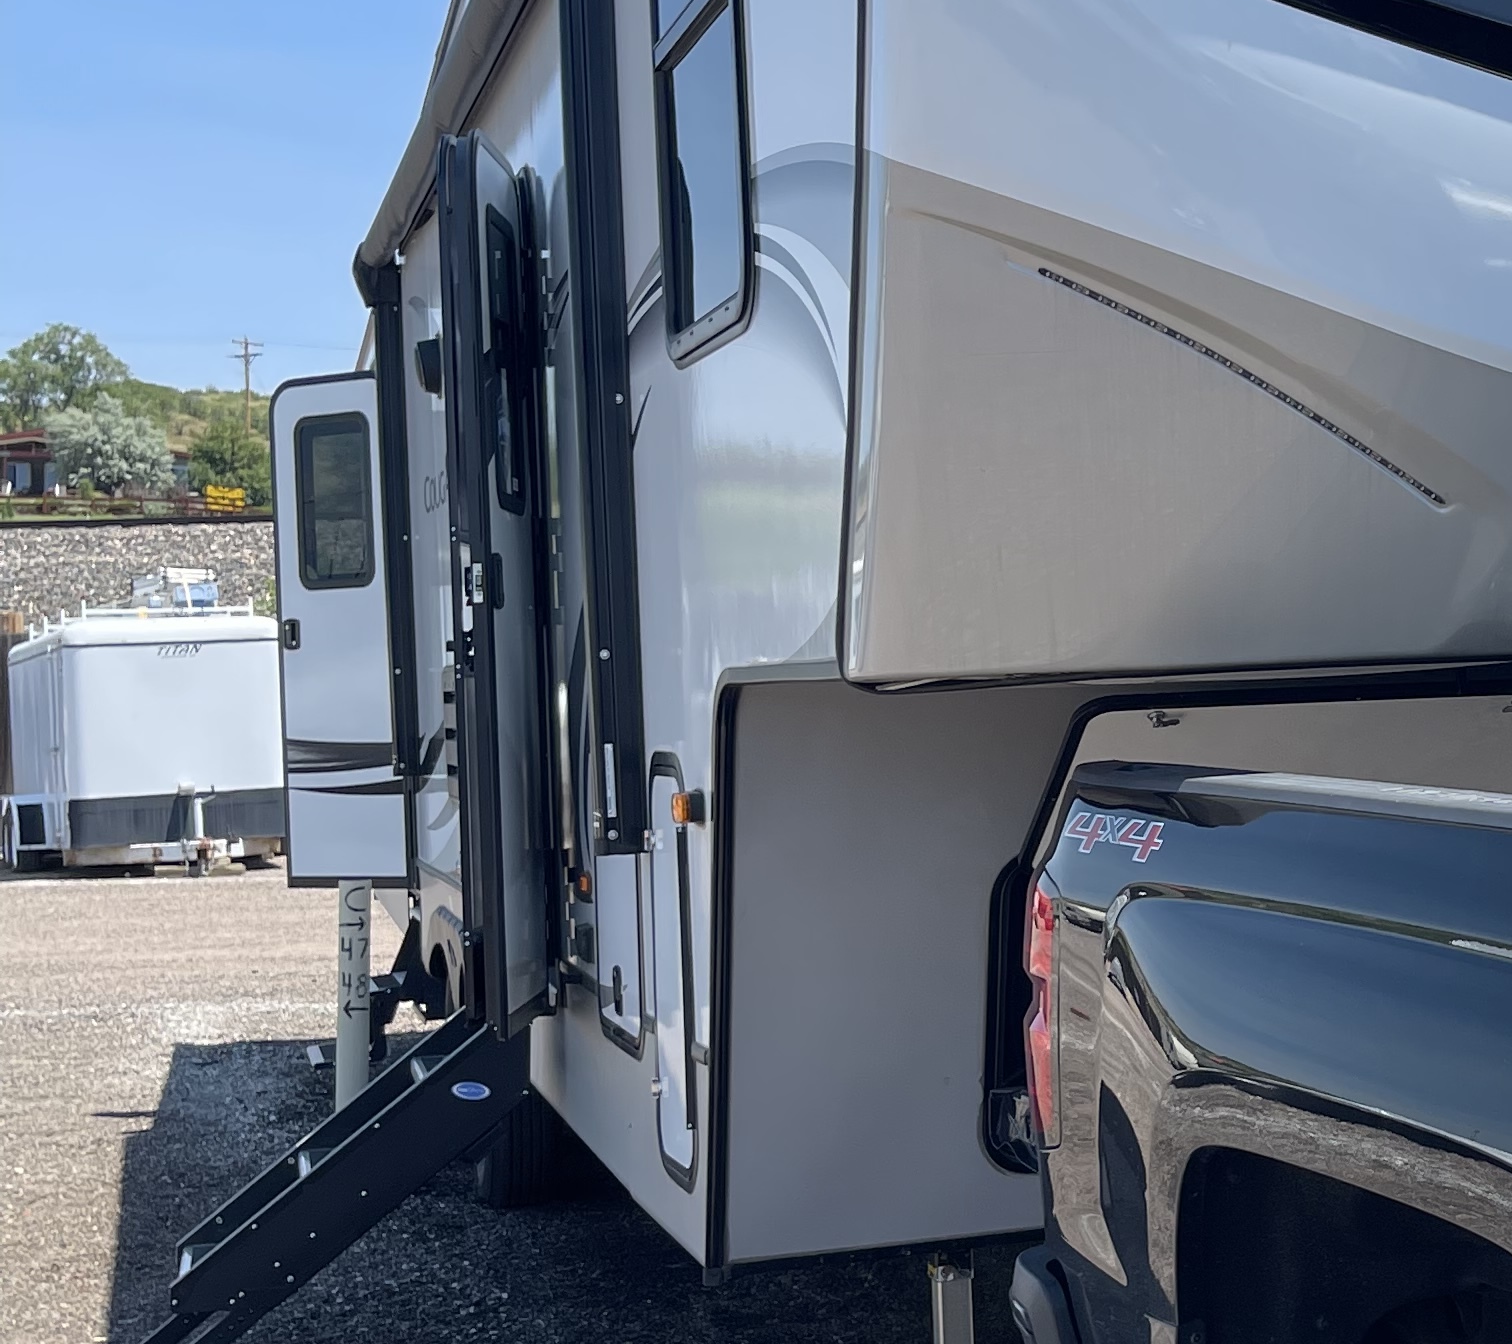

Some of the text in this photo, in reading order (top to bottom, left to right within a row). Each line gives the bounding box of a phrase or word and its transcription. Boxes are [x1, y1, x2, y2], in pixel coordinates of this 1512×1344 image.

[423, 469, 449, 513] COUG
[157, 643, 202, 657] TITAN
[341, 936, 369, 960] 47
[341, 971, 368, 999] 48
